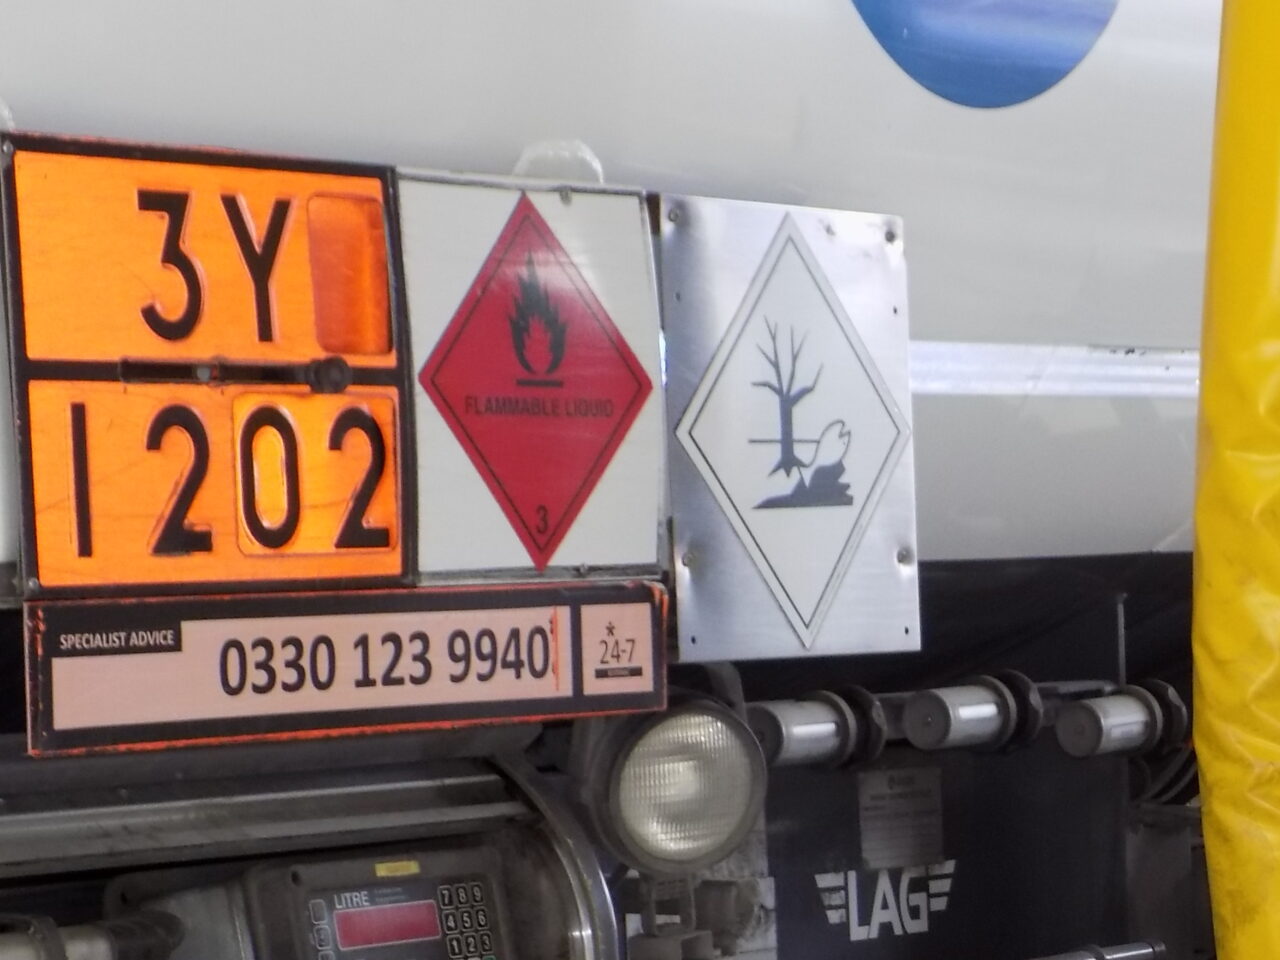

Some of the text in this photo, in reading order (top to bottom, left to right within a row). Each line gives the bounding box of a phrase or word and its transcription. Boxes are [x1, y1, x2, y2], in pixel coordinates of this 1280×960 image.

[136, 188, 292, 342] 3Y
[464, 395, 614, 418] FLAMMABLE LIQUID
[69, 401, 390, 558] 1202
[534, 504, 549, 536] 3
[59, 629, 175, 650] SPECIALIST ADVICE
[599, 637, 636, 664] 24-7
[219, 625, 550, 697] 0330 123 9940
[333, 891, 370, 909] LITRE
[847, 864, 929, 942] LAG
